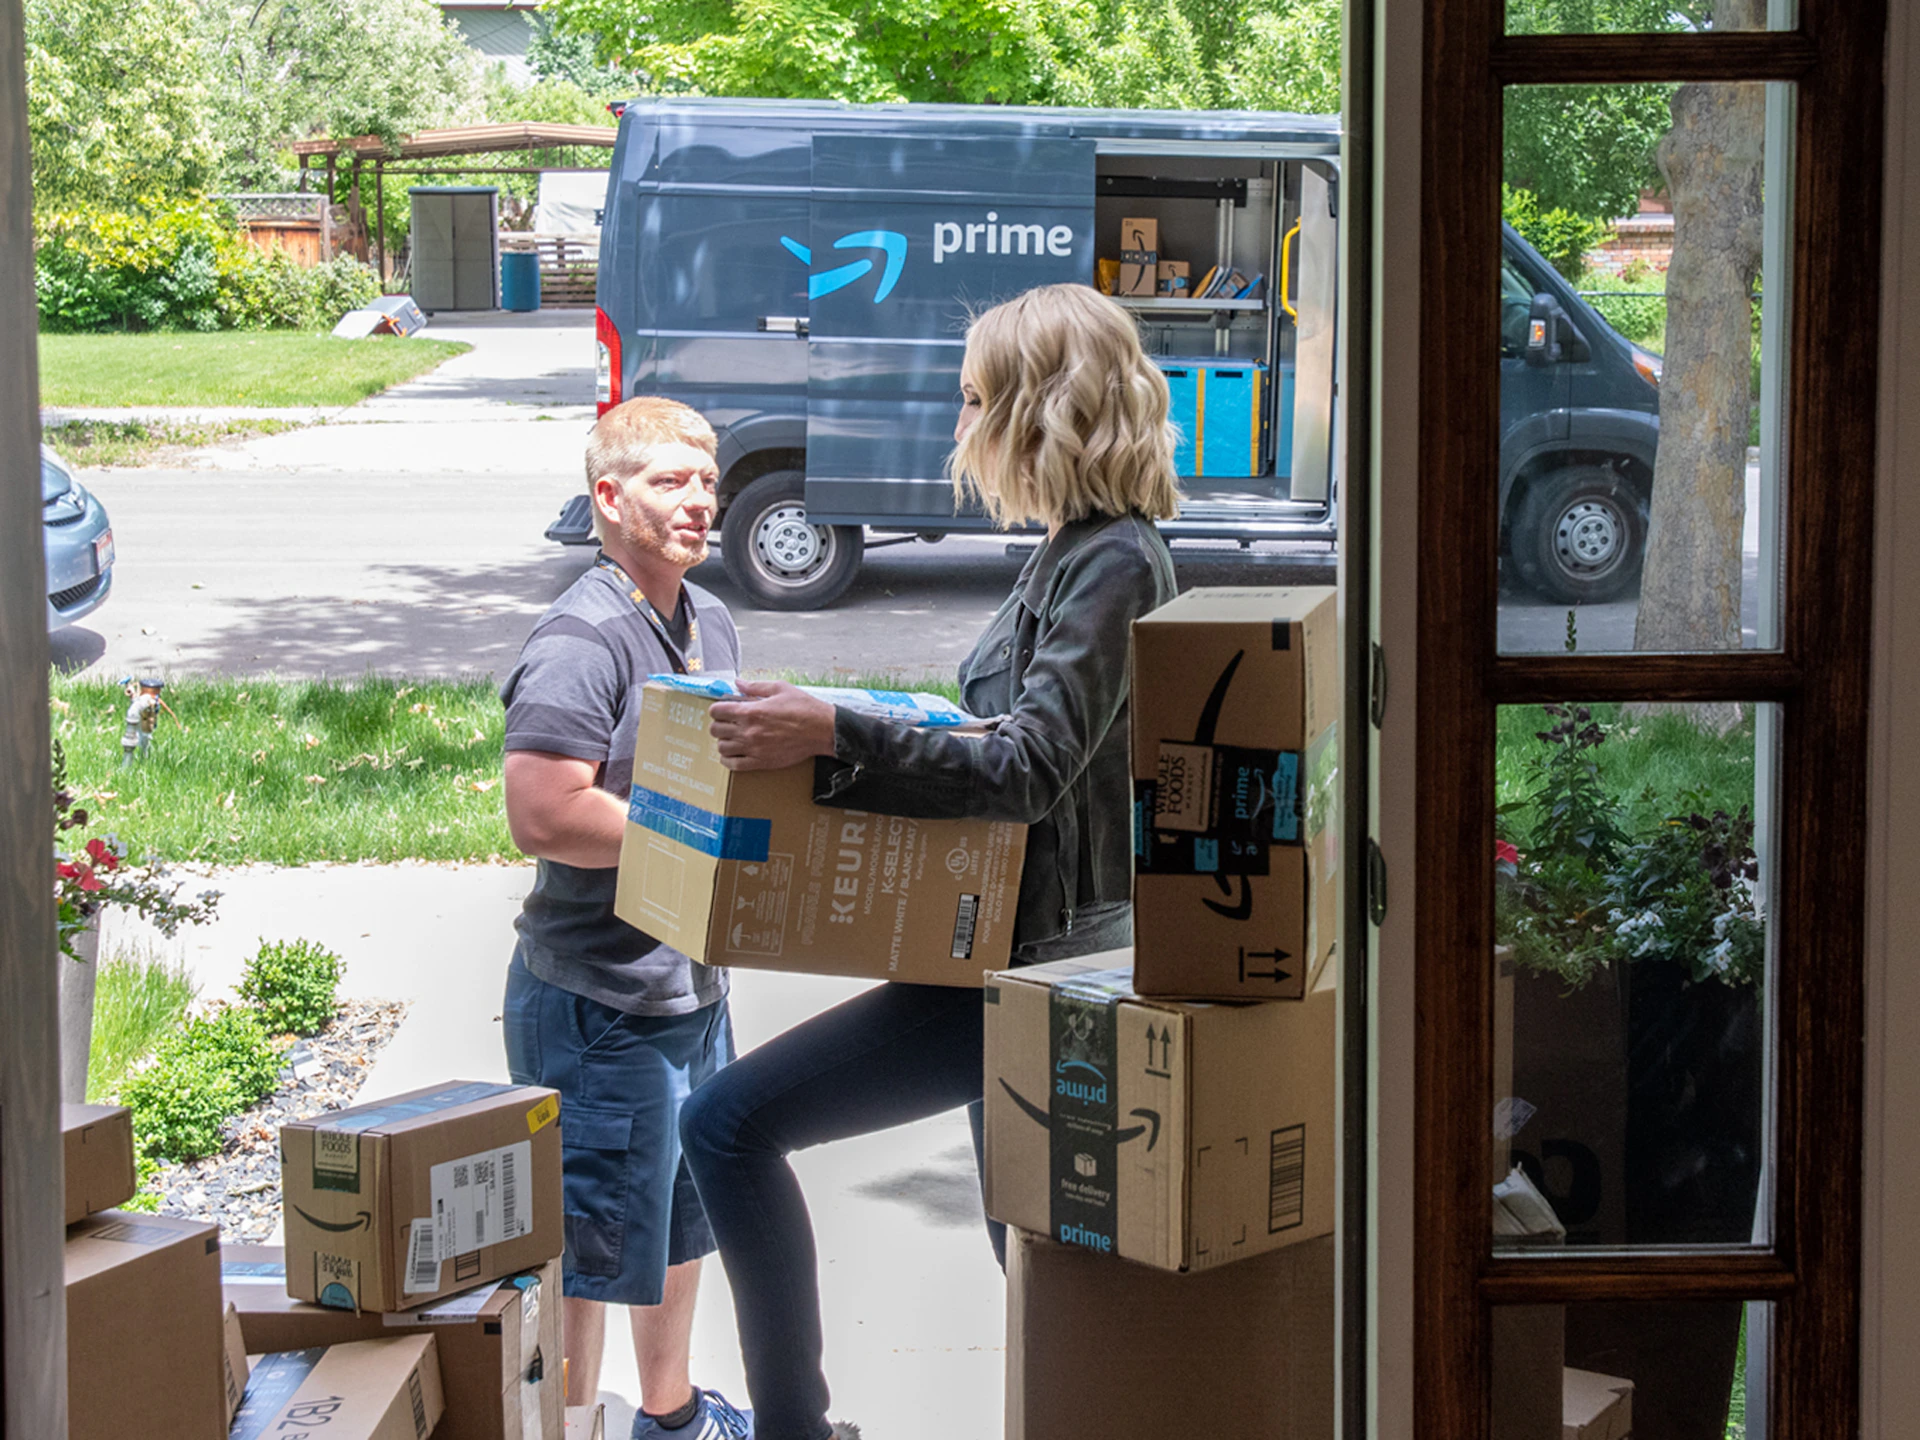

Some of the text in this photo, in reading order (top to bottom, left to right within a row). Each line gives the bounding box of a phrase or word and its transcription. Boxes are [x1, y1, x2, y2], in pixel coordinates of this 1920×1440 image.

[933, 211, 1074, 263] prime
[667, 701, 705, 730] KEURIG
[1170, 756, 1185, 816] FOODS
[1233, 766, 1249, 819] prime
[906, 826, 917, 850] MAT
[1001, 822, 1014, 856] DOMÉST
[829, 808, 867, 925] KEURI
[864, 815, 885, 915] MODEL/MODÈLE/MO
[900, 852, 914, 888] BLANC
[893, 898, 907, 934] WHITE
[887, 935, 902, 972] MATTE
[1056, 1079, 1107, 1105] prime
[321, 1141, 352, 1153] FOODS
[1060, 1178, 1078, 1191] free
[1078, 1184, 1111, 1201] delivery
[1060, 1222, 1111, 1252] prime
[277, 1395, 343, 1431] 1B2
